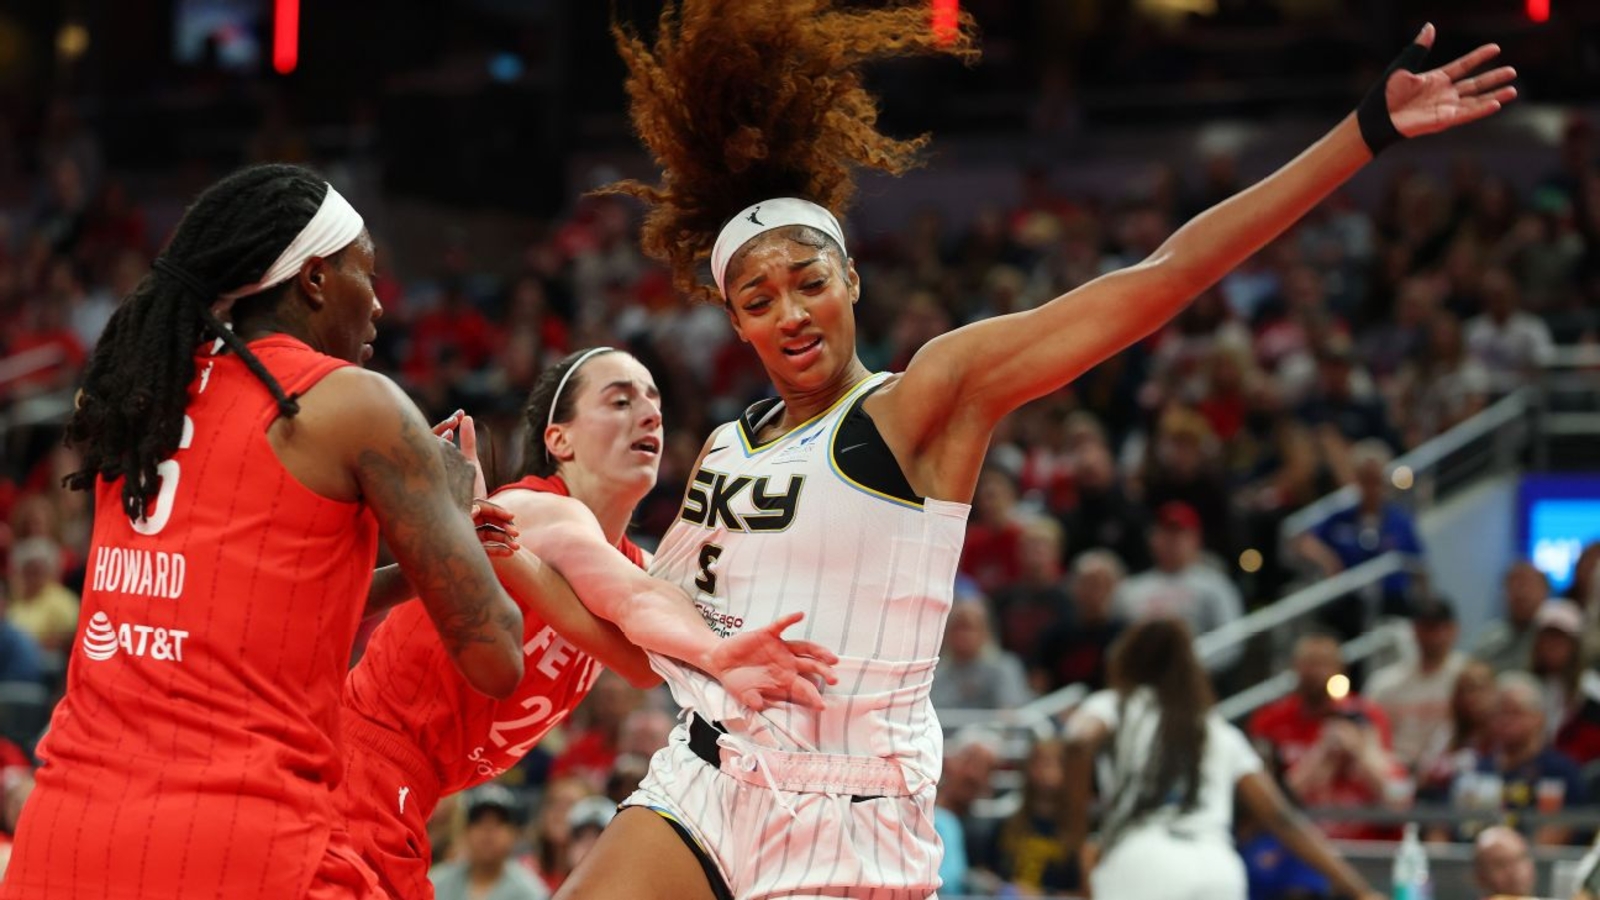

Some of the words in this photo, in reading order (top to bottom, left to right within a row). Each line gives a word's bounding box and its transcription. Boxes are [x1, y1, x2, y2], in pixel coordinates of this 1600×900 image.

[680, 467, 807, 534] SKY
[92, 546, 187, 600] HOWARD
[117, 622, 190, 662] AT&T
[488, 695, 570, 758] 22
